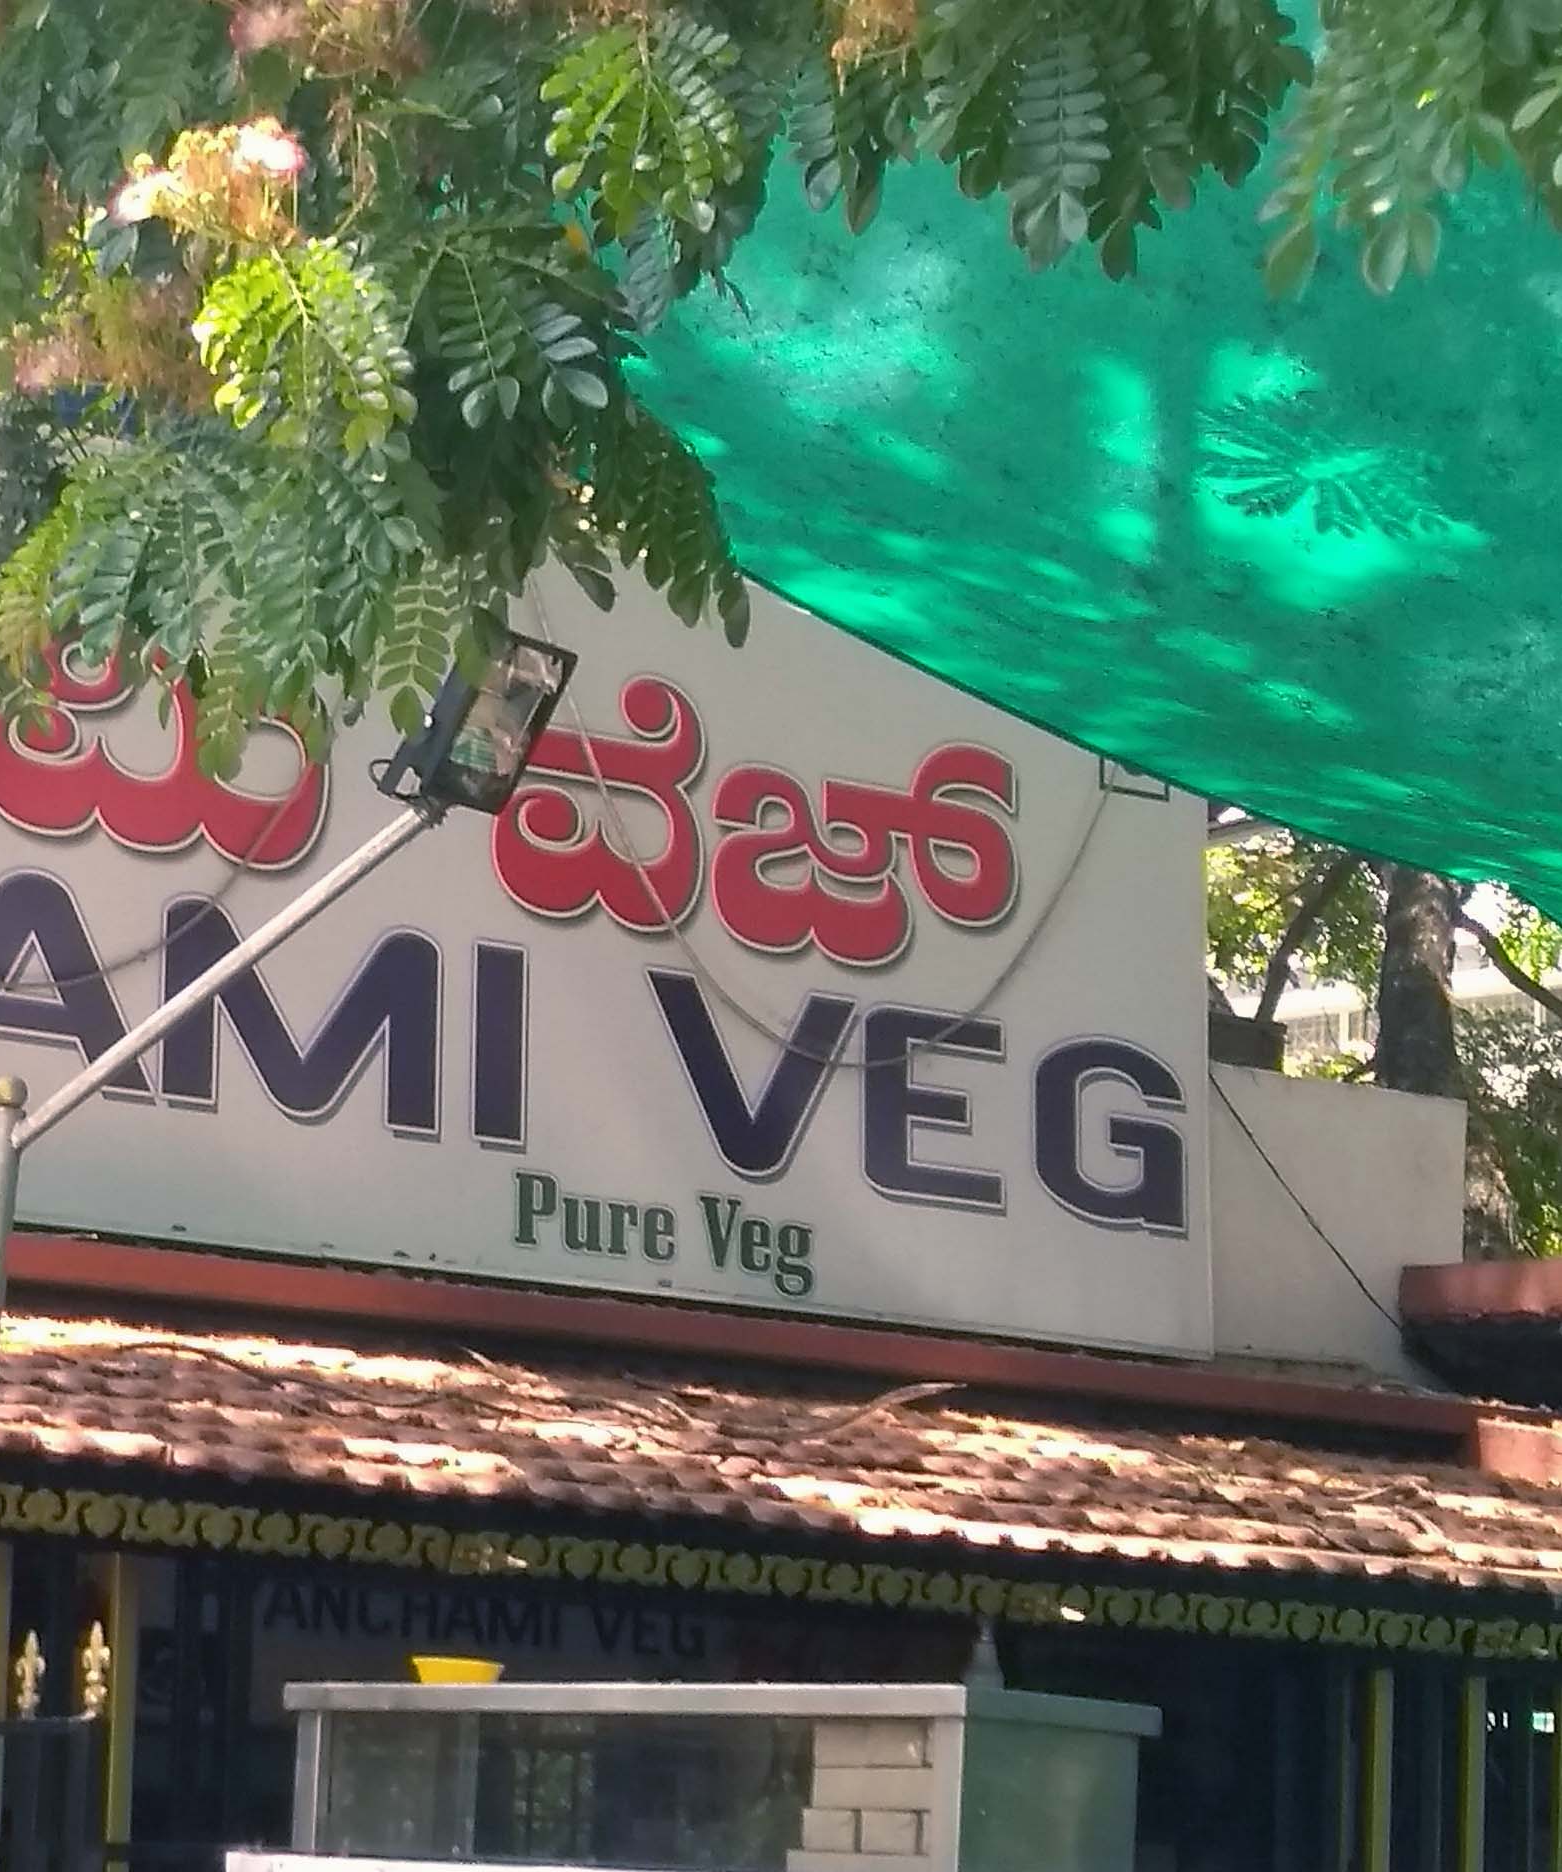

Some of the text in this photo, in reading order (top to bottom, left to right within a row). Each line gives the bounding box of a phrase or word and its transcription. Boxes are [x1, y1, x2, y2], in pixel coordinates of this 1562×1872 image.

[491, 672, 1020, 968] ವೆಜ್
[647, 967, 1188, 1237] VEG
[514, 1170, 814, 1297] Pure Veg
[261, 1582, 708, 1658] ANCHAMI VEG
